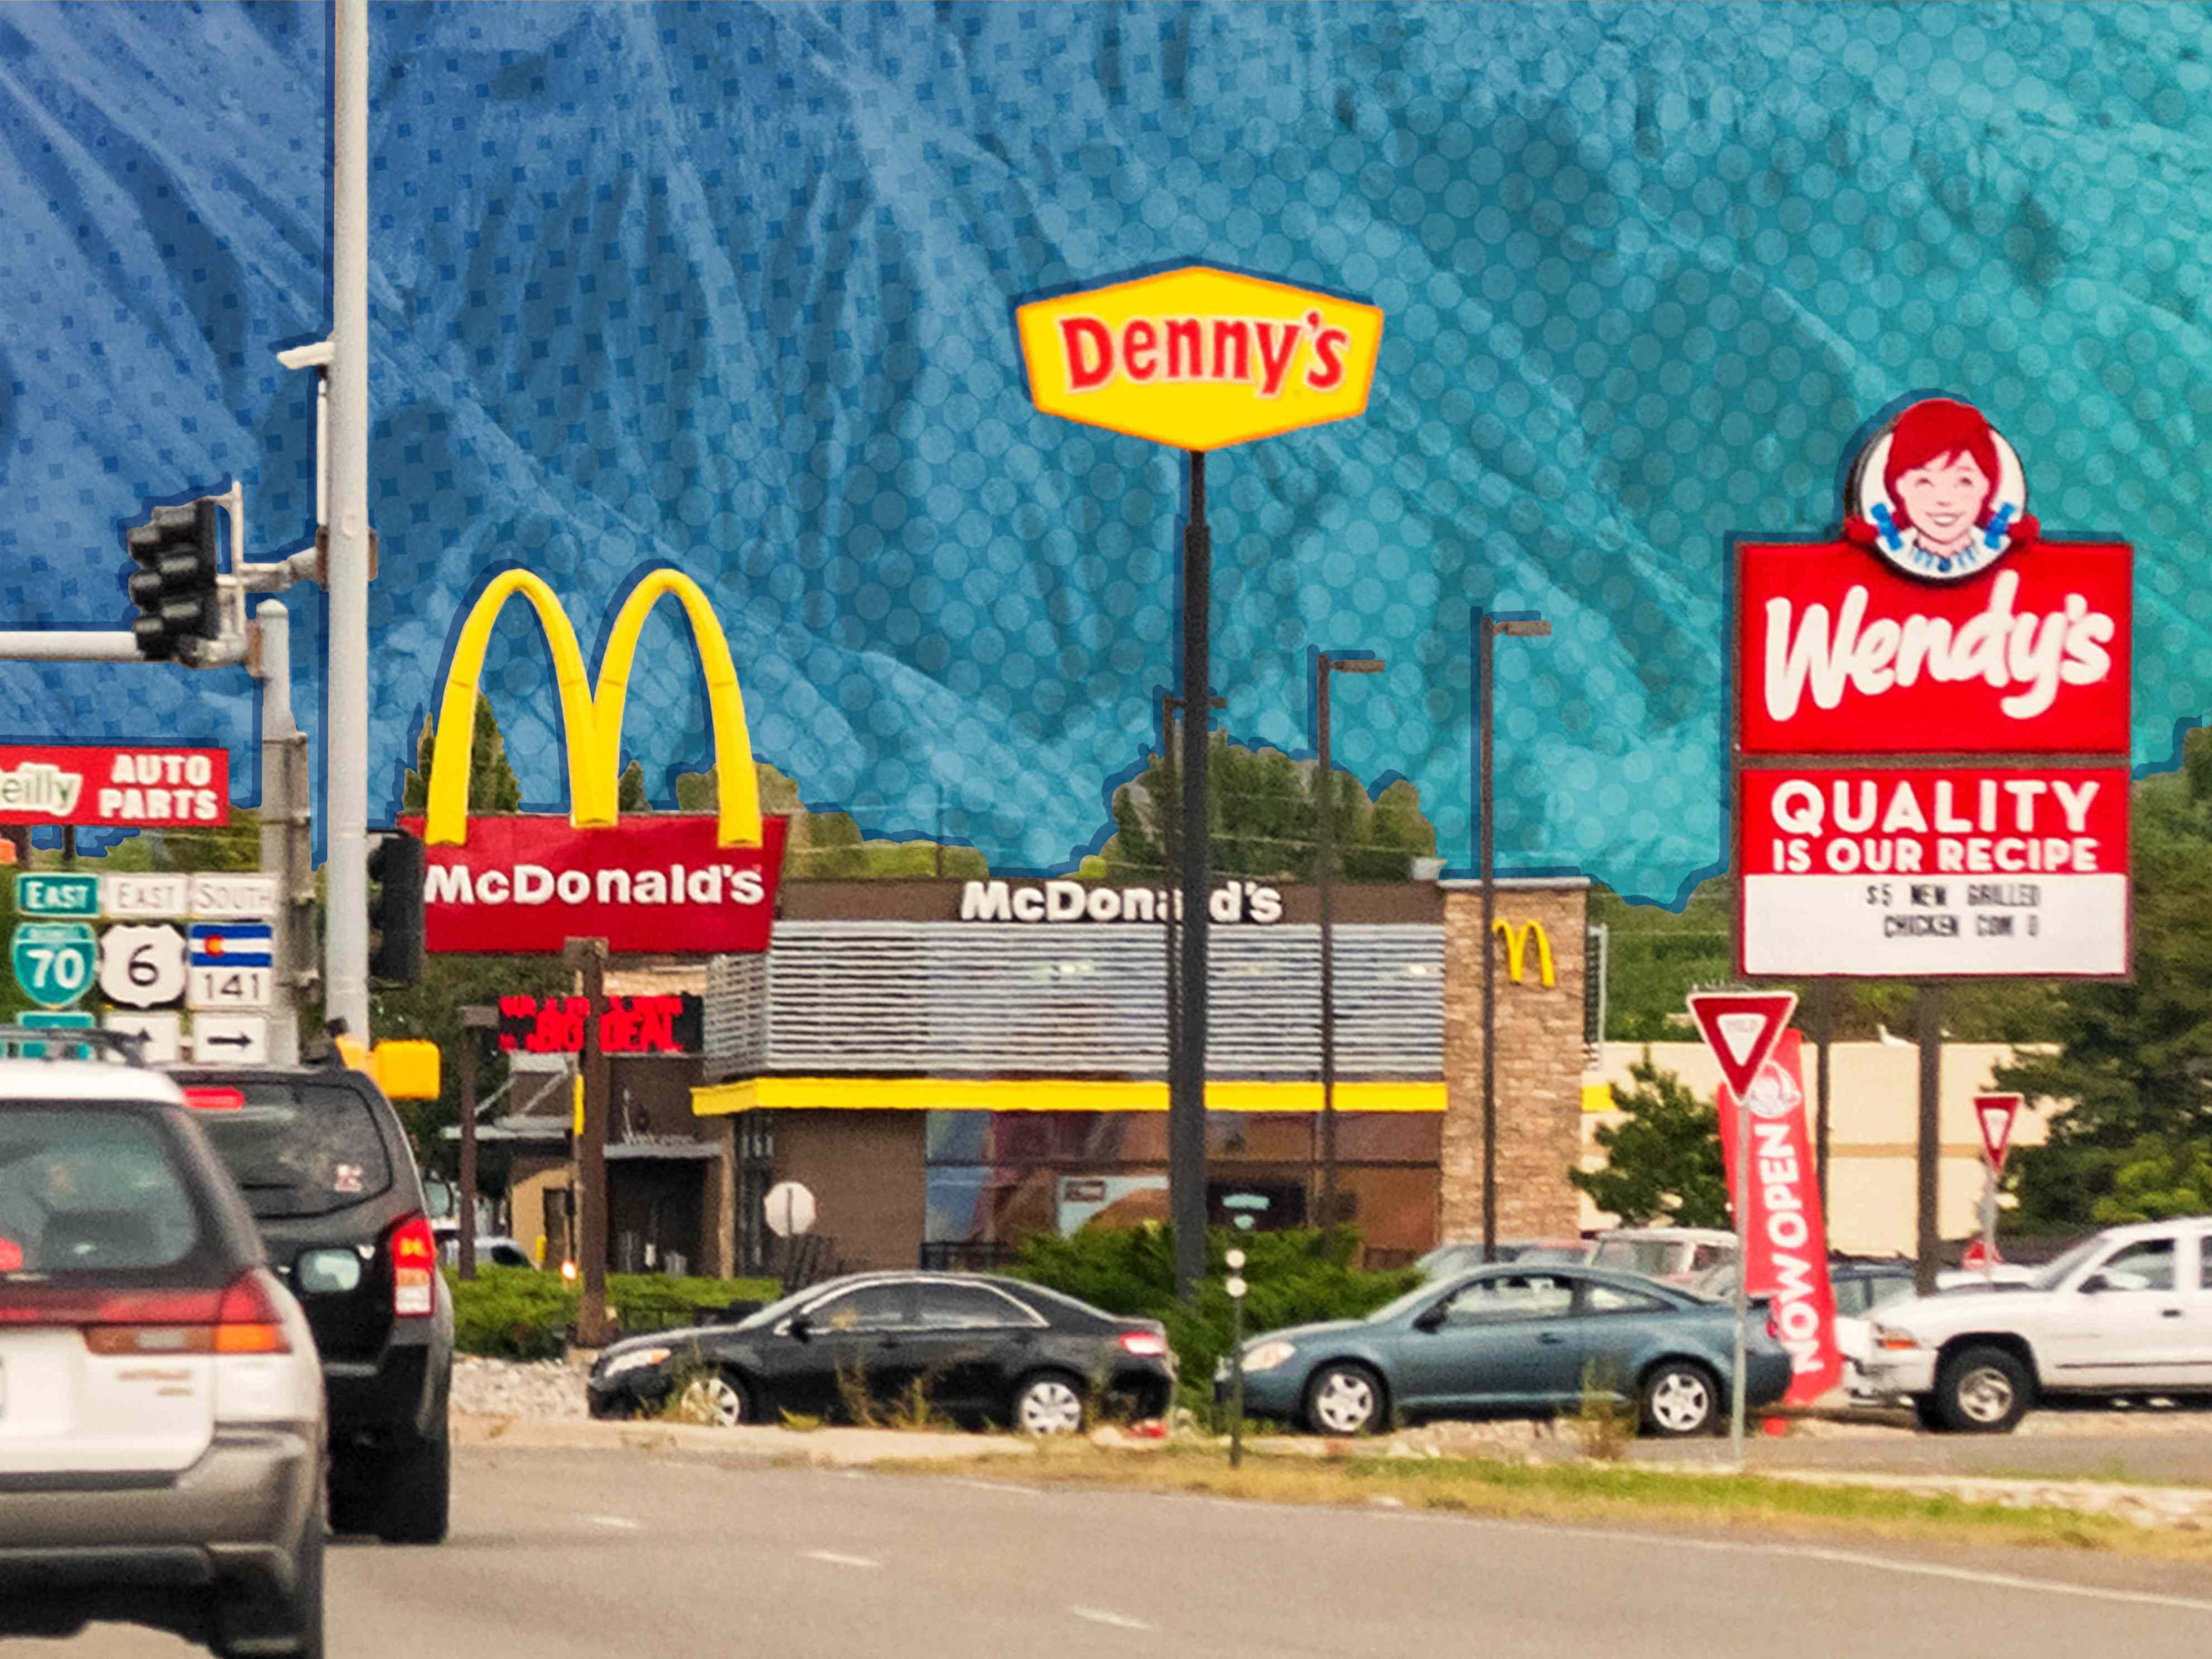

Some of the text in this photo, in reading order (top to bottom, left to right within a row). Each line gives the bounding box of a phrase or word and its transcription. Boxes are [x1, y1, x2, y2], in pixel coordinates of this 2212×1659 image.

[1058, 310, 1347, 396] Denny's
[1765, 569, 2114, 721] Wendy's
[110, 754, 211, 785] AUTO
[99, 789, 218, 819] PARTS
[1771, 780, 2100, 837] QUALITY
[1773, 837, 2099, 872] IS OUR RECIPE
[27, 881, 88, 909] EAST
[118, 882, 175, 909] EAST
[195, 883, 272, 910] SOUTH
[423, 864, 765, 905] McDonald's
[961, 880, 1283, 922] McDonad's
[1911, 884, 1947, 906] NEW
[1885, 915, 1959, 937] CHICKEN
[27, 948, 85, 989] 70
[127, 944, 159, 987] 6
[204, 973, 260, 997] 141
[1755, 1123, 1824, 1375] NOW OPEN
